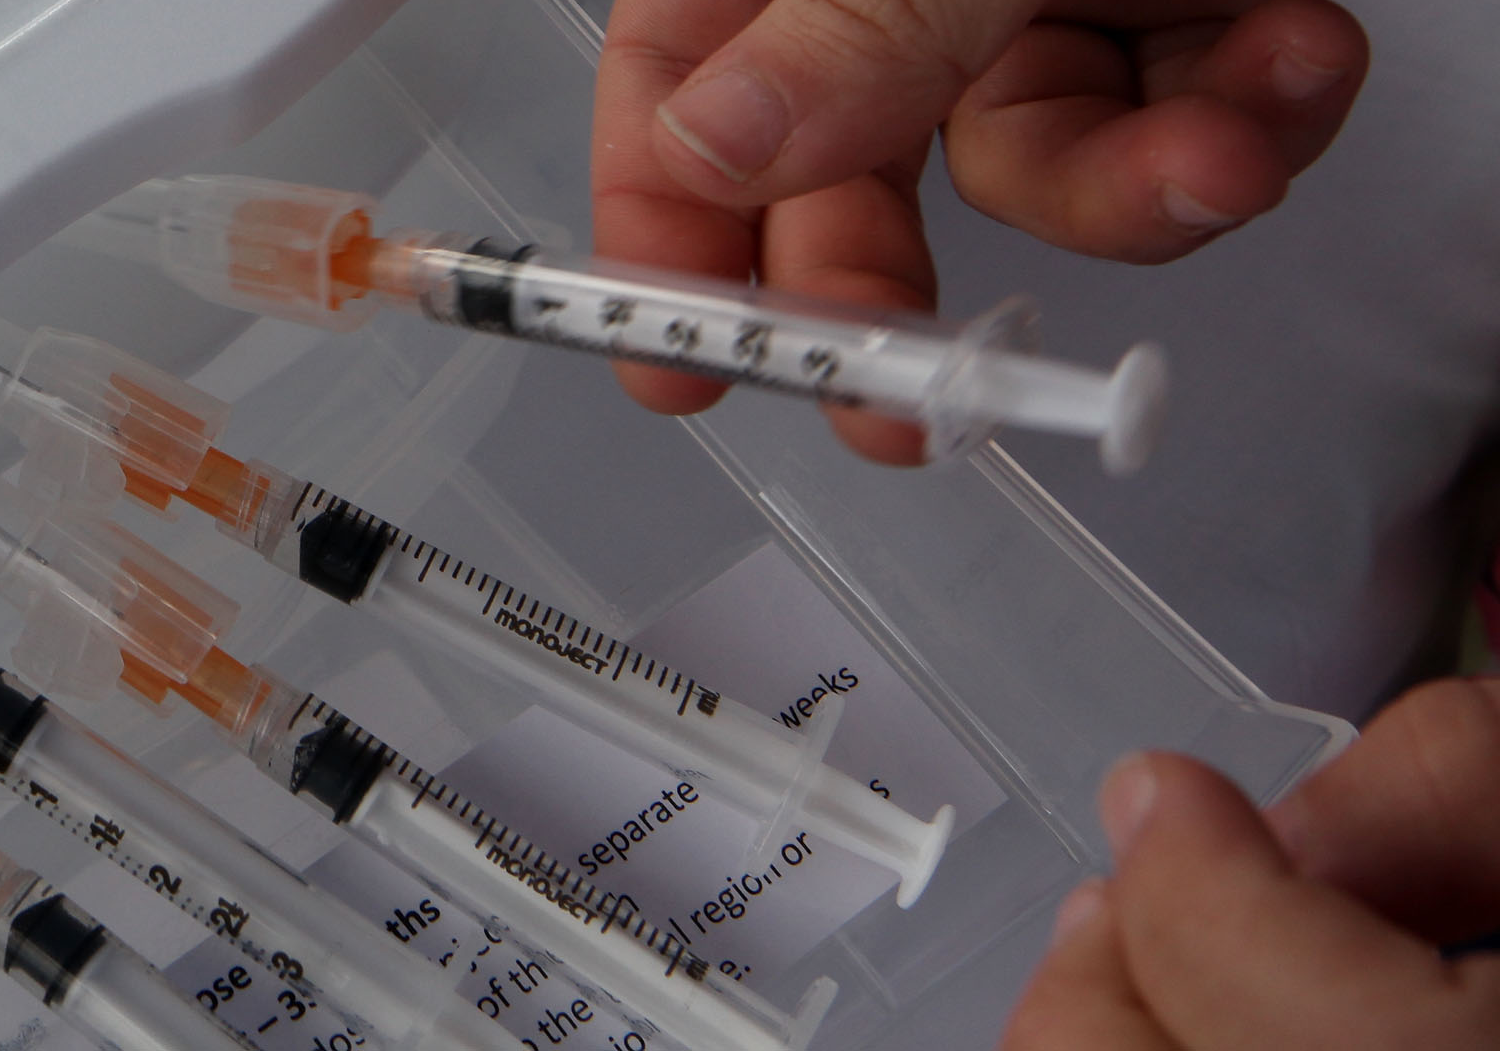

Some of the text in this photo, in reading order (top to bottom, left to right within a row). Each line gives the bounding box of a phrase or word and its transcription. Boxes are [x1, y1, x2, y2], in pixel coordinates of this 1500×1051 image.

[577, 781, 700, 877] separate
[780, 831, 813, 867] or
[384, 898, 442, 944] ths
[476, 958, 550, 1020] of th
[537, 998, 595, 1045] the
